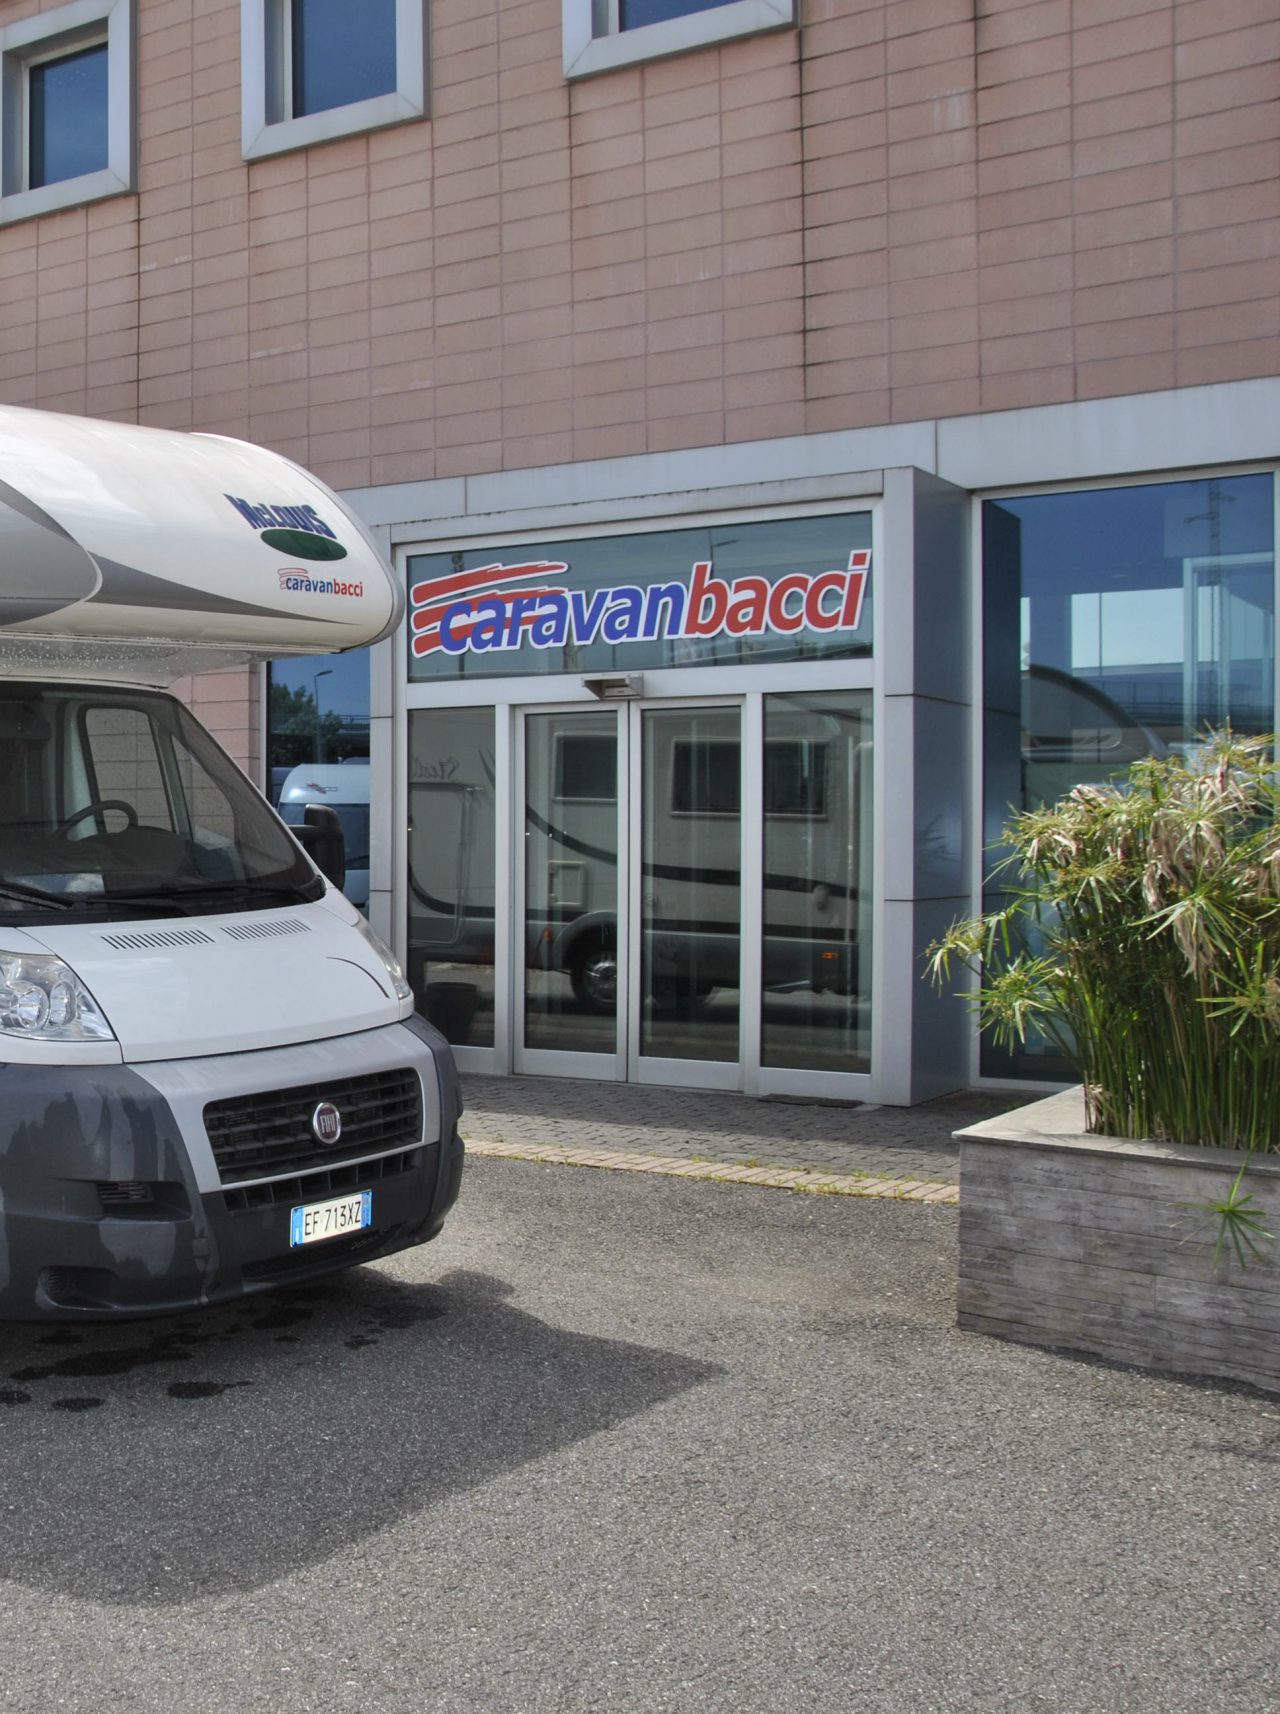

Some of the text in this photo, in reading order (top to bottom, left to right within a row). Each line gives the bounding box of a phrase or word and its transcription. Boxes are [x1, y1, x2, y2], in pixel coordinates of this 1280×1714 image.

[285, 577, 363, 597] caravanbacci
[437, 549, 872, 656] caravanbacci
[320, 1113, 337, 1134] FIAT
[305, 1210, 320, 1236] EF
[325, 1200, 361, 1232] 713XZ
